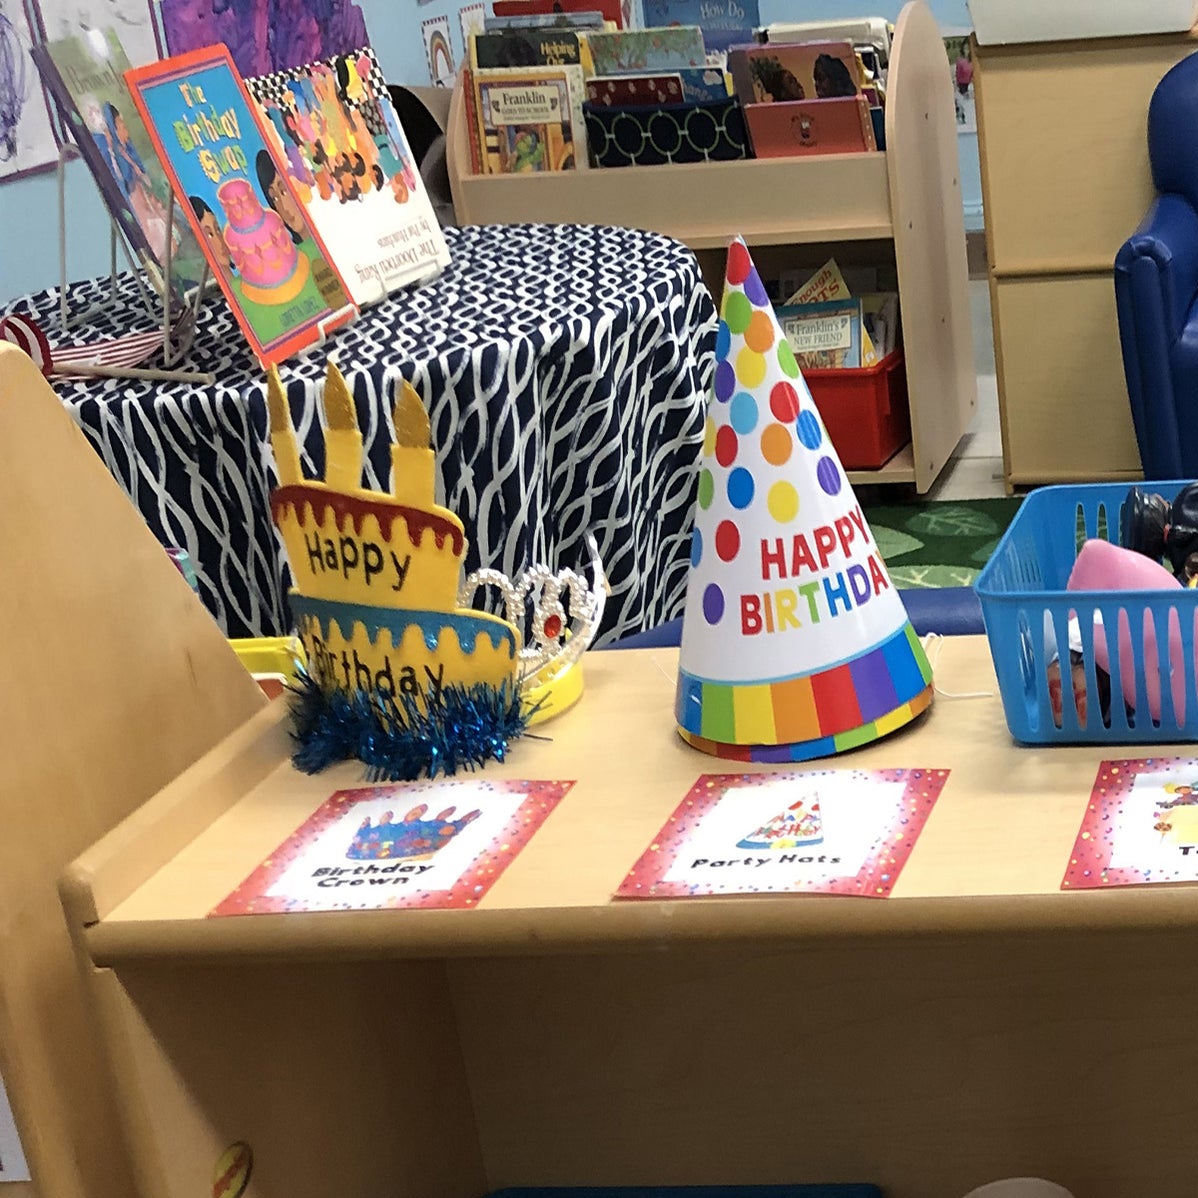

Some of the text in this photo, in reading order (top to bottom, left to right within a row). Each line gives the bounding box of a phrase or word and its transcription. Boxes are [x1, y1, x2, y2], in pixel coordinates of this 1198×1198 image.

[540, 40, 576, 58] Helping
[178, 82, 207, 108] The
[502, 91, 546, 105] Franklin
[172, 104, 241, 153] Birthday
[198, 145, 248, 184] Swap
[419, 239, 440, 257] The
[354, 263, 380, 284] Rang
[795, 321, 840, 336] Franklin's
[793, 332, 844, 346] NEW FRIEND
[760, 504, 870, 581] HAPPY
[305, 532, 411, 592] Happy
[740, 551, 889, 636] BIRTHDA
[311, 862, 437, 878] Birthday
[690, 853, 842, 869] Party Hats
[316, 875, 409, 889] Crown
